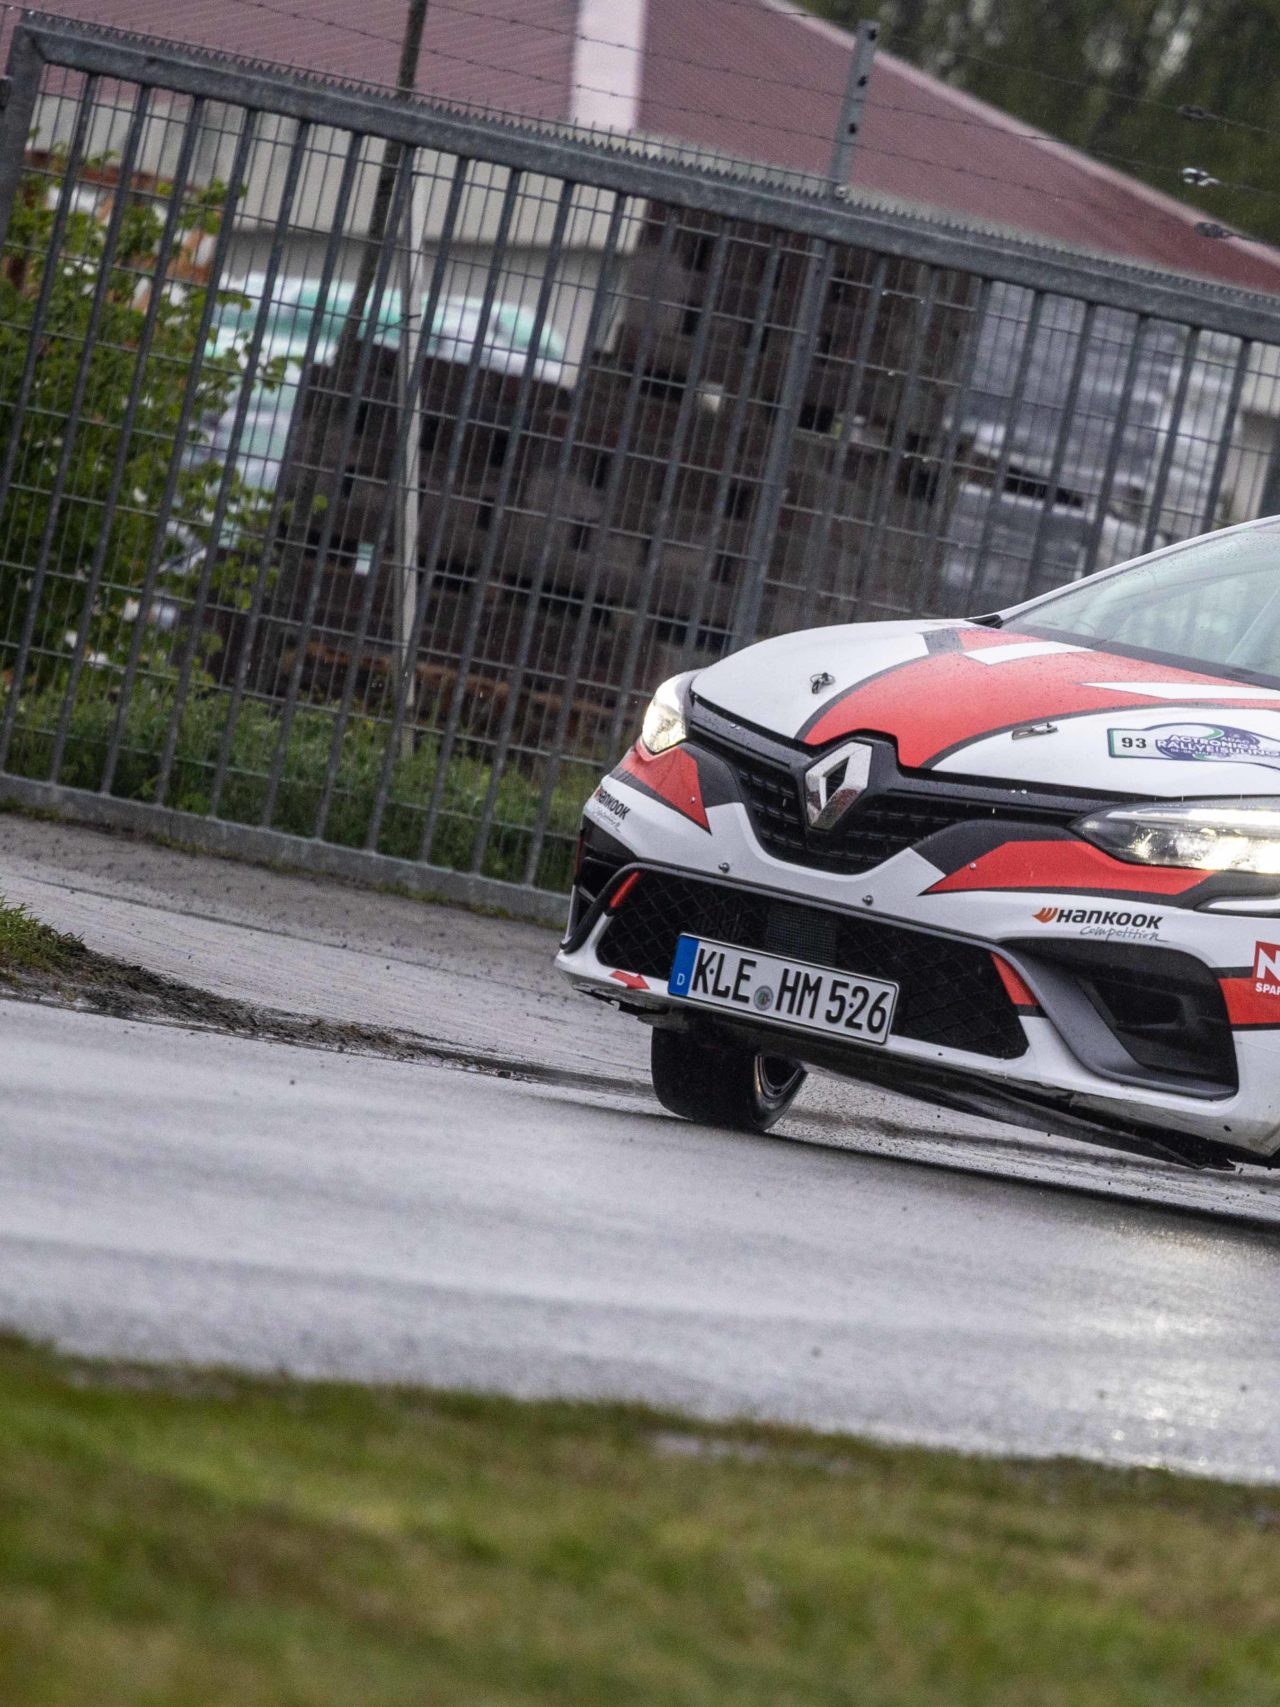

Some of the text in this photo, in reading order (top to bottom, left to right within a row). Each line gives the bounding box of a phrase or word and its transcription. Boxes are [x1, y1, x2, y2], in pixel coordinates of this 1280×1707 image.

[1121, 737, 1147, 748] 93
[1157, 739, 1215, 754] RALLYE
[1169, 734, 1259, 750] ACTRONICS
[676, 972, 686, 986] D
[691, 948, 890, 1034] KLE HM 526
